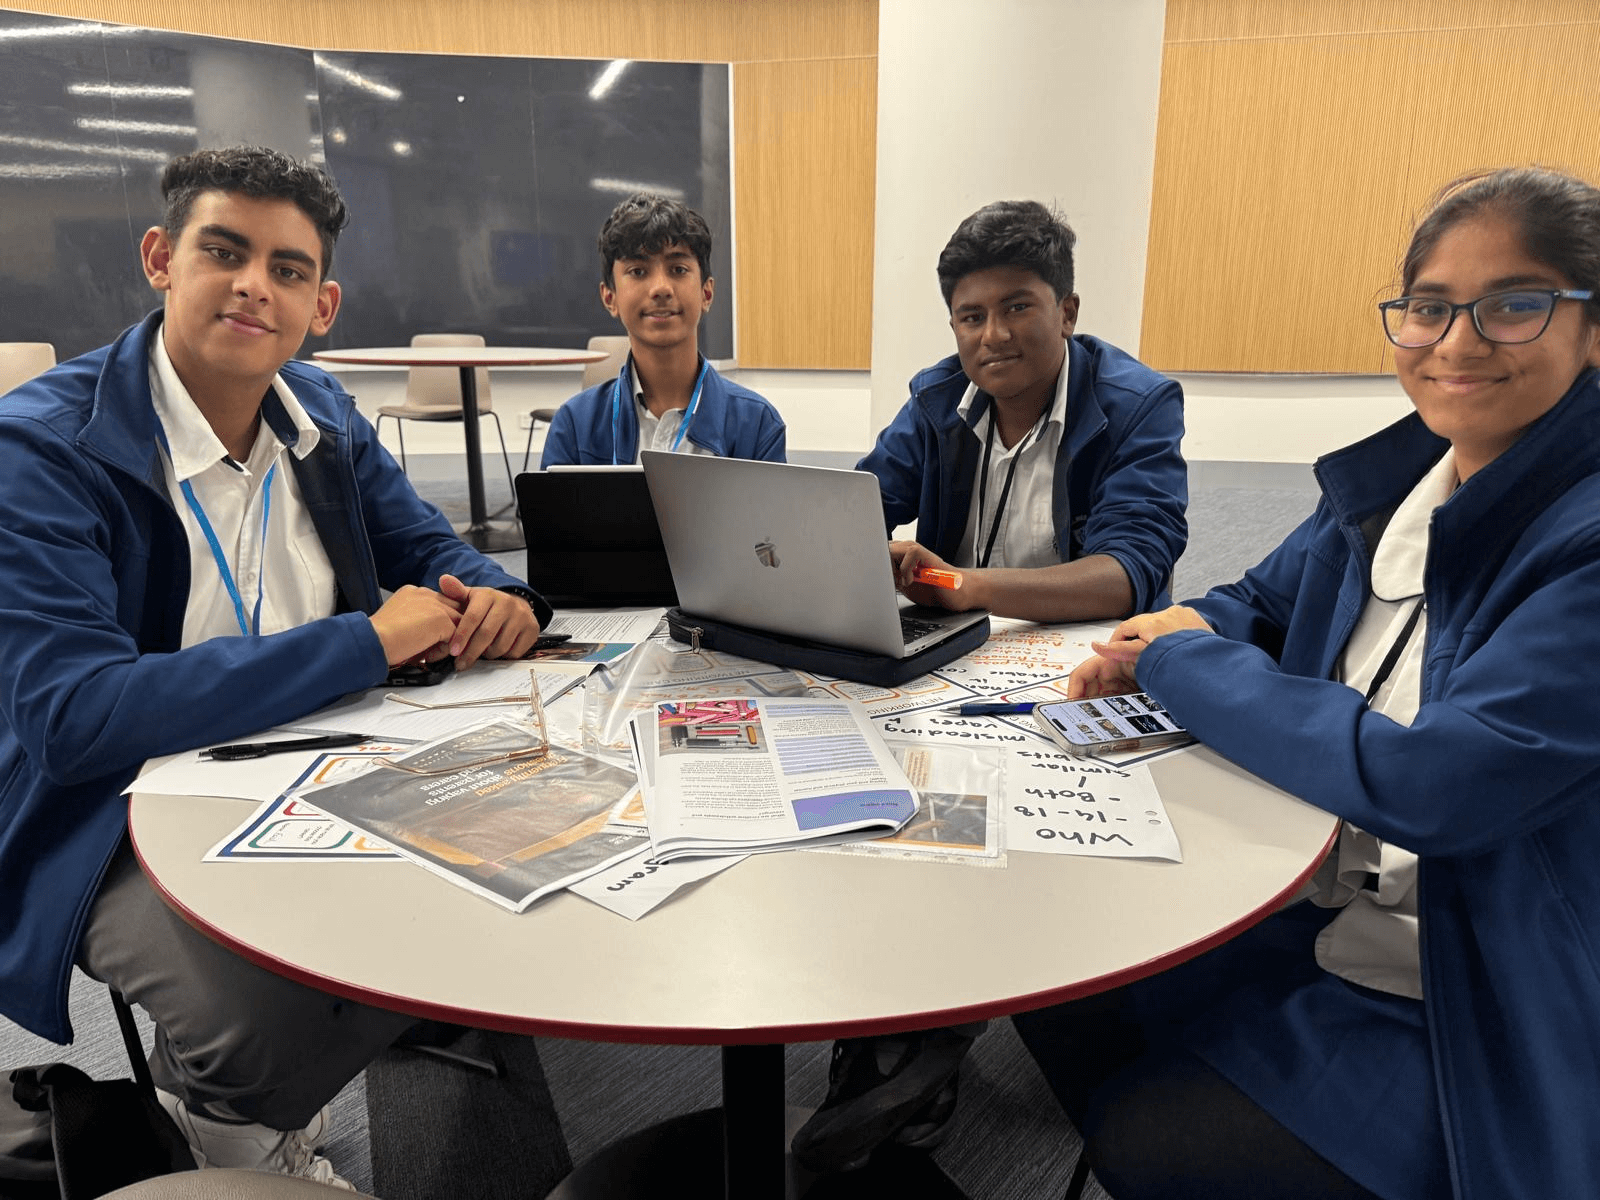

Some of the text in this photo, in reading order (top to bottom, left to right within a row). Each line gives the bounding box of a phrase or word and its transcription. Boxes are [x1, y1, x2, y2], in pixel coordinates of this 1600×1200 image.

[866, 697, 944, 715] NETWORKING
[884, 723, 1026, 742] misleading
[929, 718, 998, 729] vapes
[419, 773, 460, 791] carers
[428, 769, 494, 796] for parents
[470, 773, 503, 789] about
[474, 755, 568, 797] Frequently asked
[424, 785, 469, 806] vaping
[1024, 788, 1096, 803] Both
[1035, 828, 1134, 847] Who
